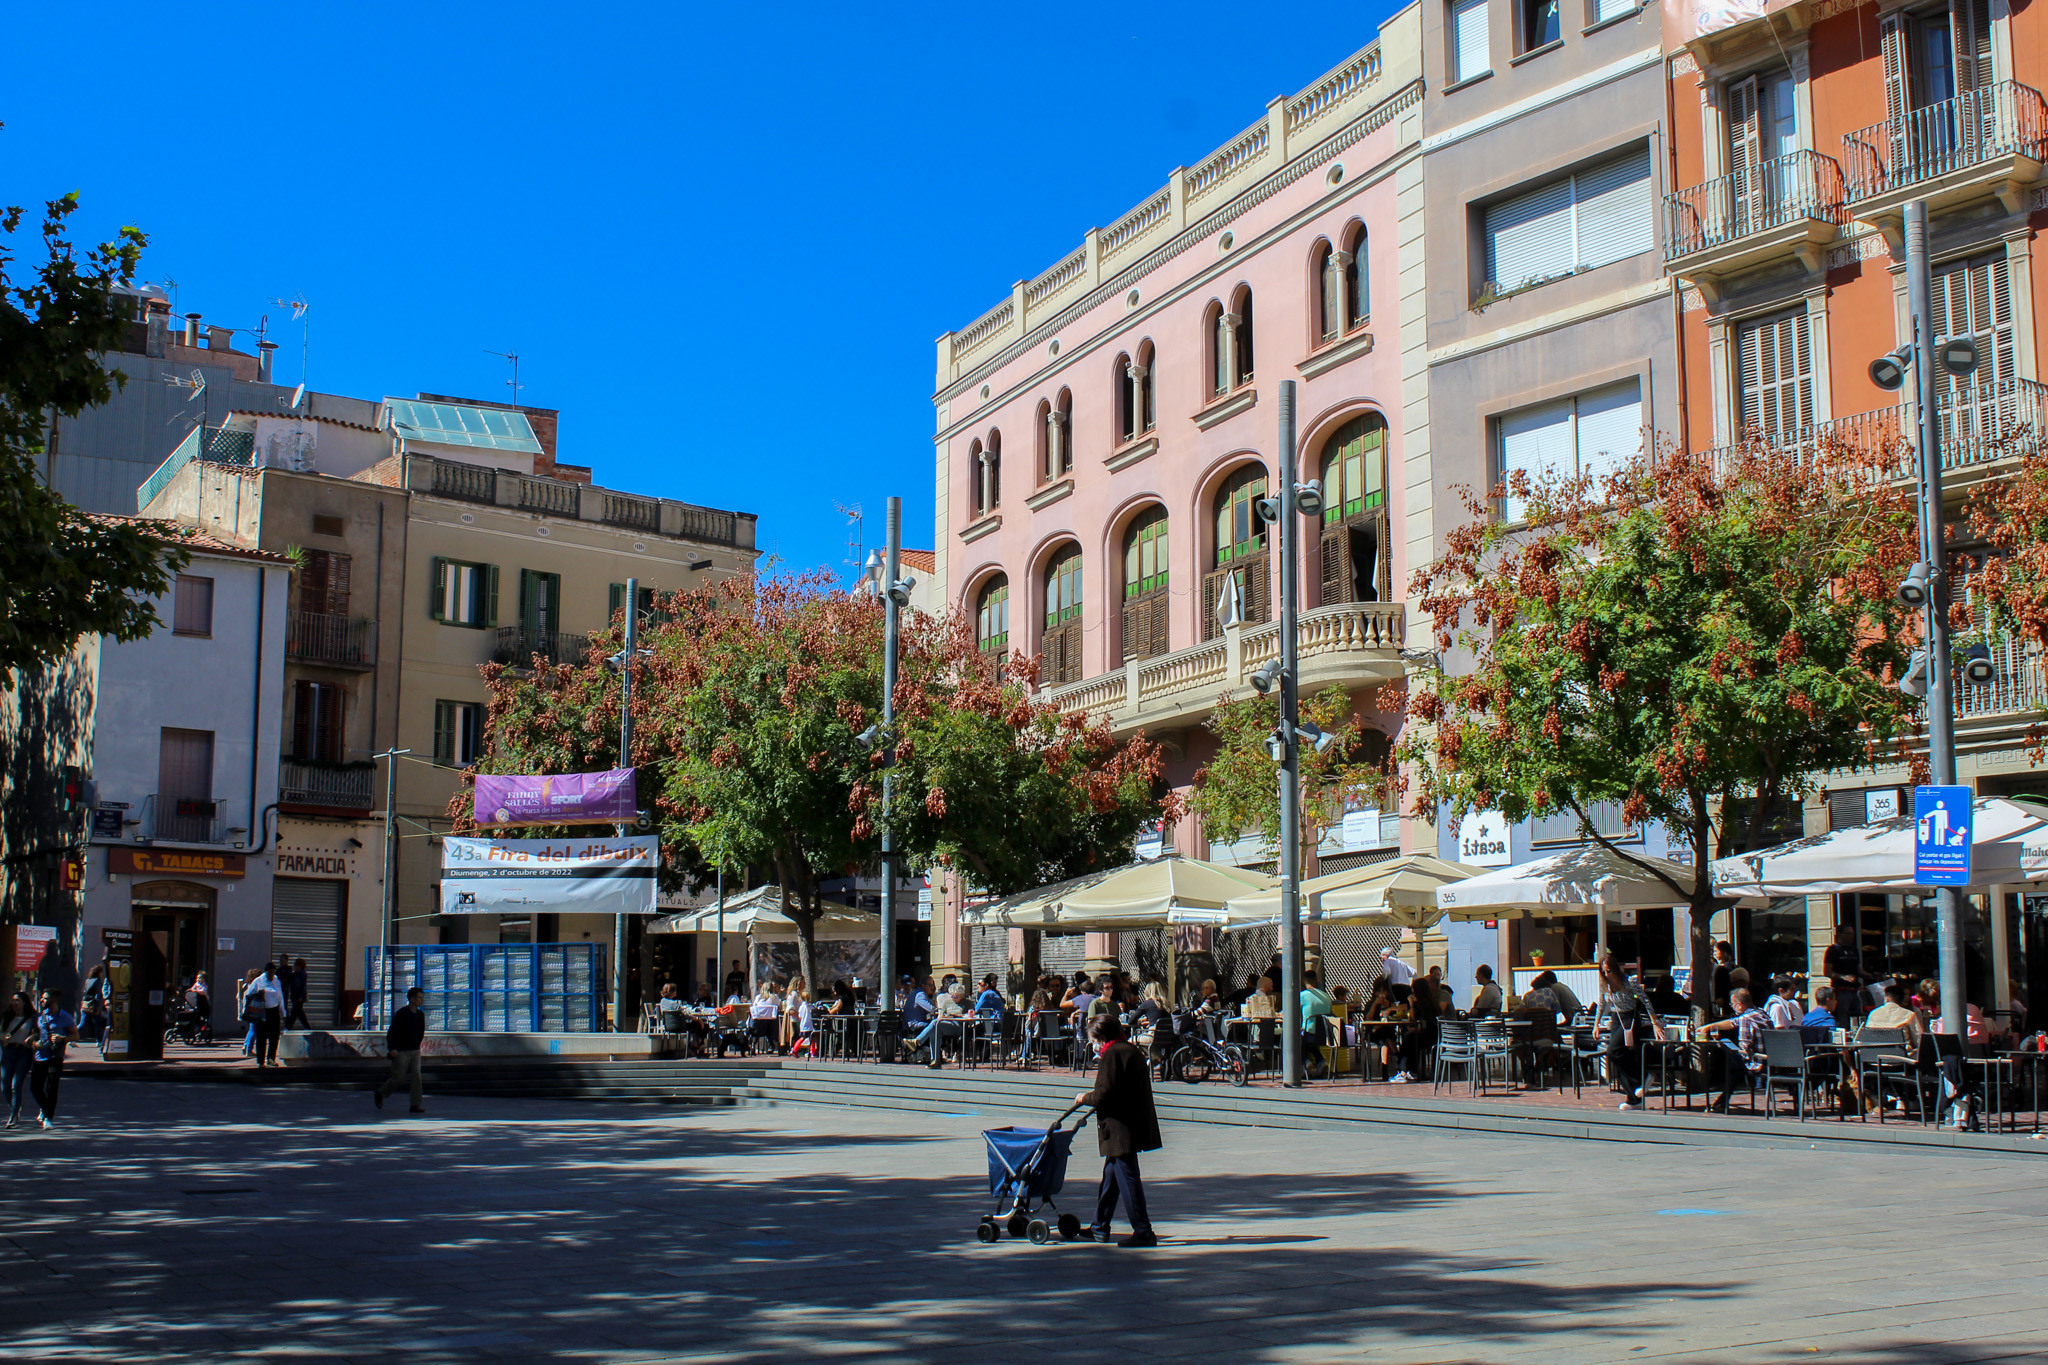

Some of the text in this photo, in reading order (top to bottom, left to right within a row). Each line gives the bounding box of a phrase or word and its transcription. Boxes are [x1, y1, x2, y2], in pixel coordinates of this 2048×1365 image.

[551, 794, 583, 805] SPORT
[1874, 798, 1890, 808] 365
[1868, 807, 1898, 822] Obrador
[488, 846, 529, 862] Fira
[537, 845, 572, 863] del
[579, 843, 648, 861] dibuix
[161, 854, 224, 869] TABACS
[277, 855, 346, 874] FARMACIA
[450, 869, 490, 878] Diumenge,
[500, 868, 537, 876] d'octubre
[539, 868, 549, 876] de
[552, 868, 572, 876] 2022
[1442, 892, 1456, 903] 365
